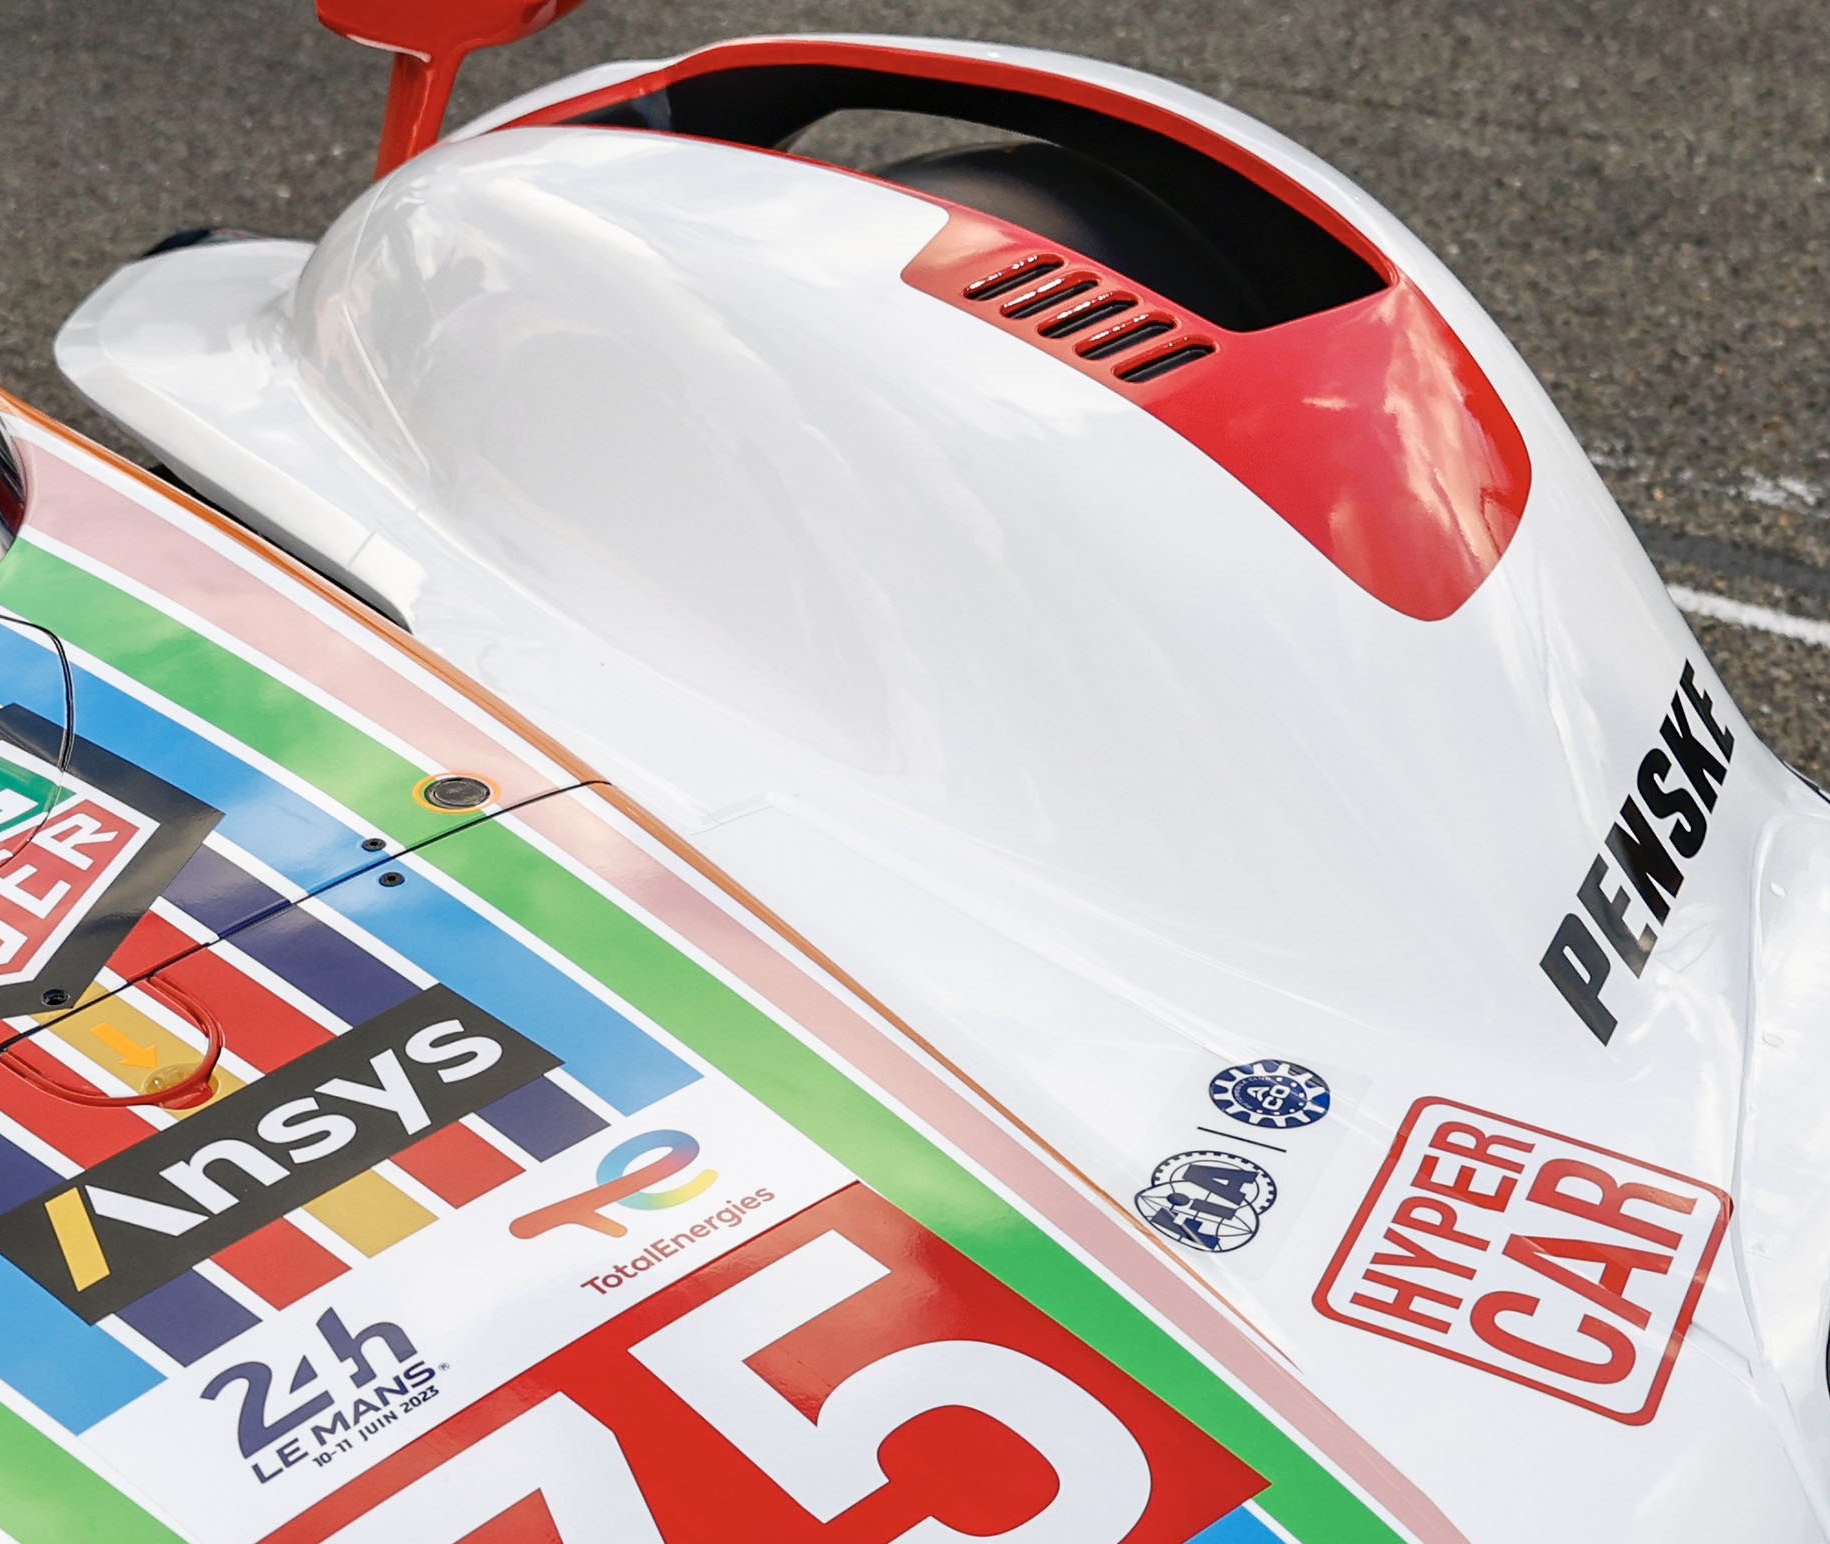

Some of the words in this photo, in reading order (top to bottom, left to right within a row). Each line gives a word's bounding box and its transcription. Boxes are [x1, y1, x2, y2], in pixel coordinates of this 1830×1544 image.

[1540, 659, 1735, 1047] PENSKE
[44, 1018, 504, 1293] Ansys
[1150, 1164, 1260, 1250] FIA
[1349, 1120, 1536, 1335] HYPER
[580, 1187, 775, 1295] TotalEnergies
[1469, 1157, 1699, 1385] CAR
[200, 1306, 418, 1460] 24h
[312, 1439, 353, 1468] 10-11
[358, 1410, 399, 1442] JUIN
[400, 1385, 440, 1414] 2023
[252, 1437, 309, 1484] LE
